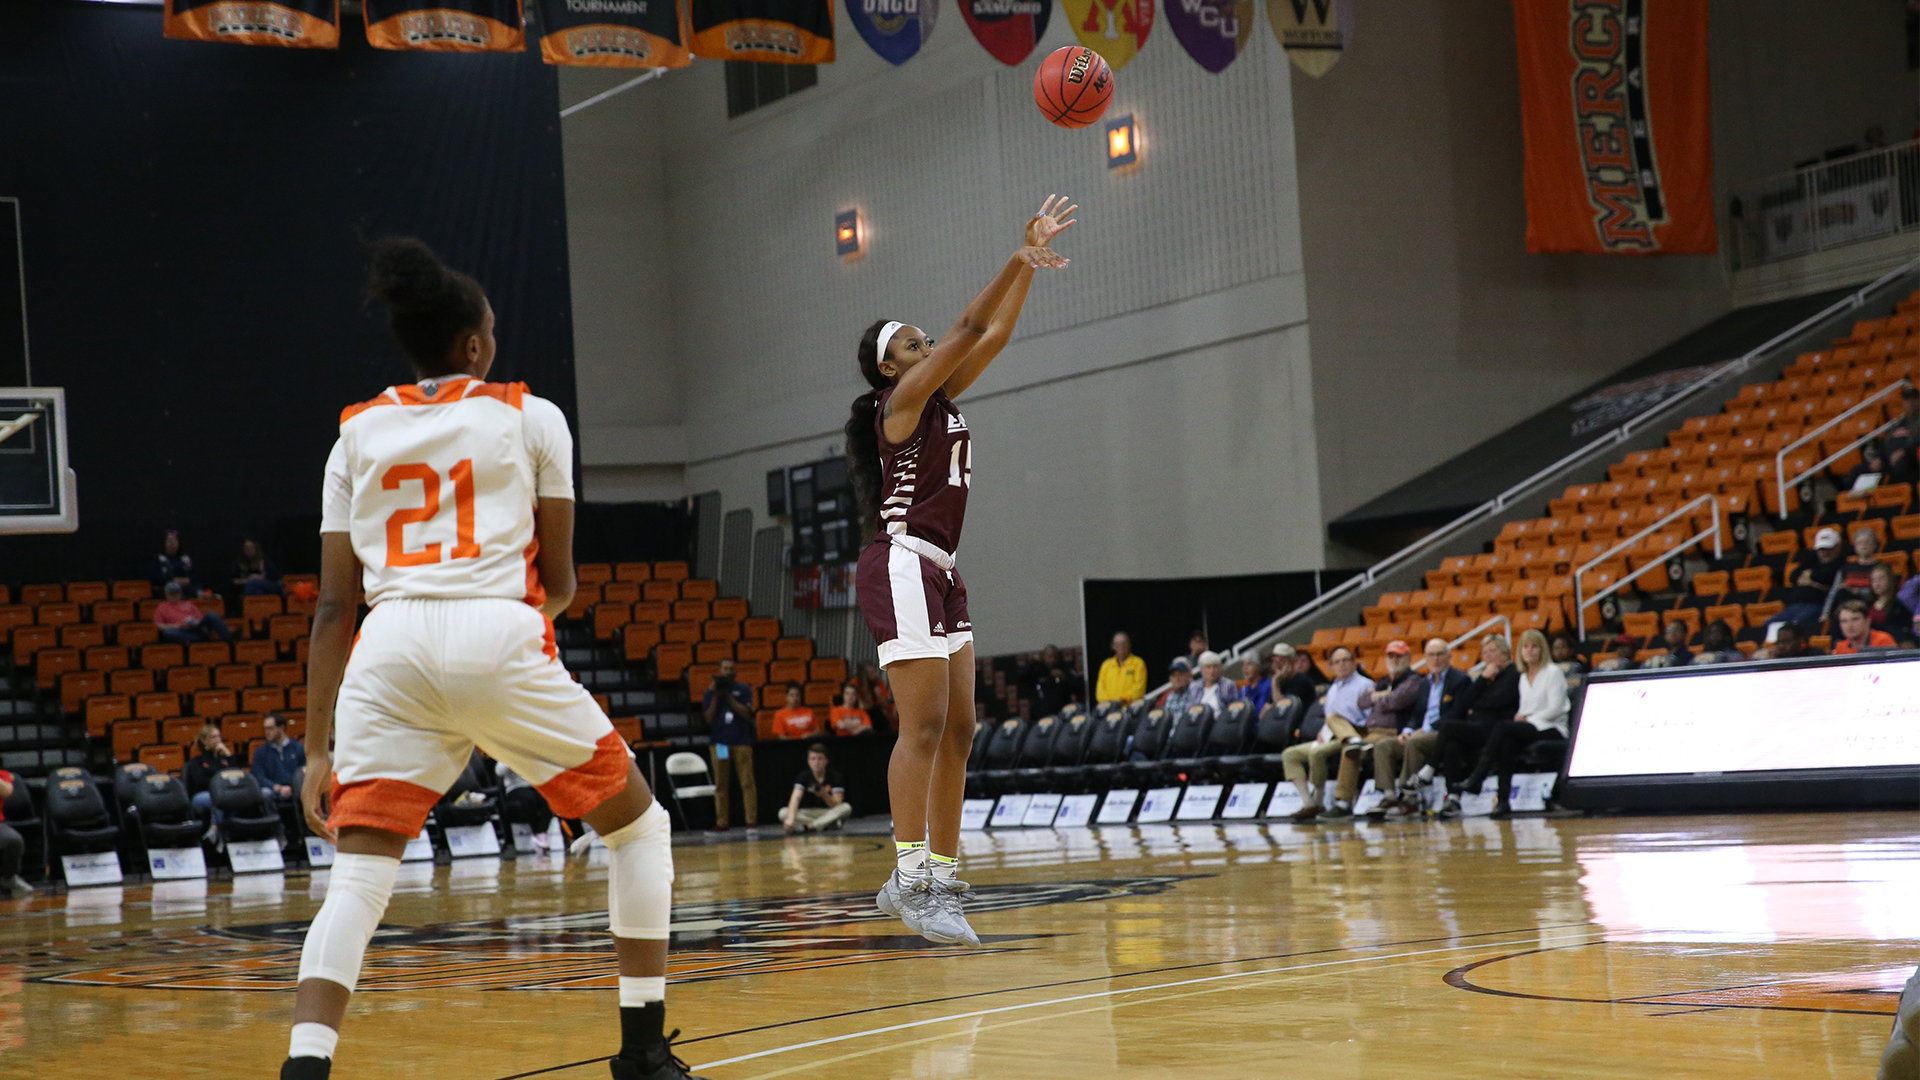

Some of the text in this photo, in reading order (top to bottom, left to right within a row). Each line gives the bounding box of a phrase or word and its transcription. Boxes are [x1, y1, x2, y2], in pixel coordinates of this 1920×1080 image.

[567, 0, 648, 13] TOURNAMENT
[1067, 48, 1094, 84] Wilso
[1574, 0, 1653, 247] MERC
[381, 458, 481, 568] 21
